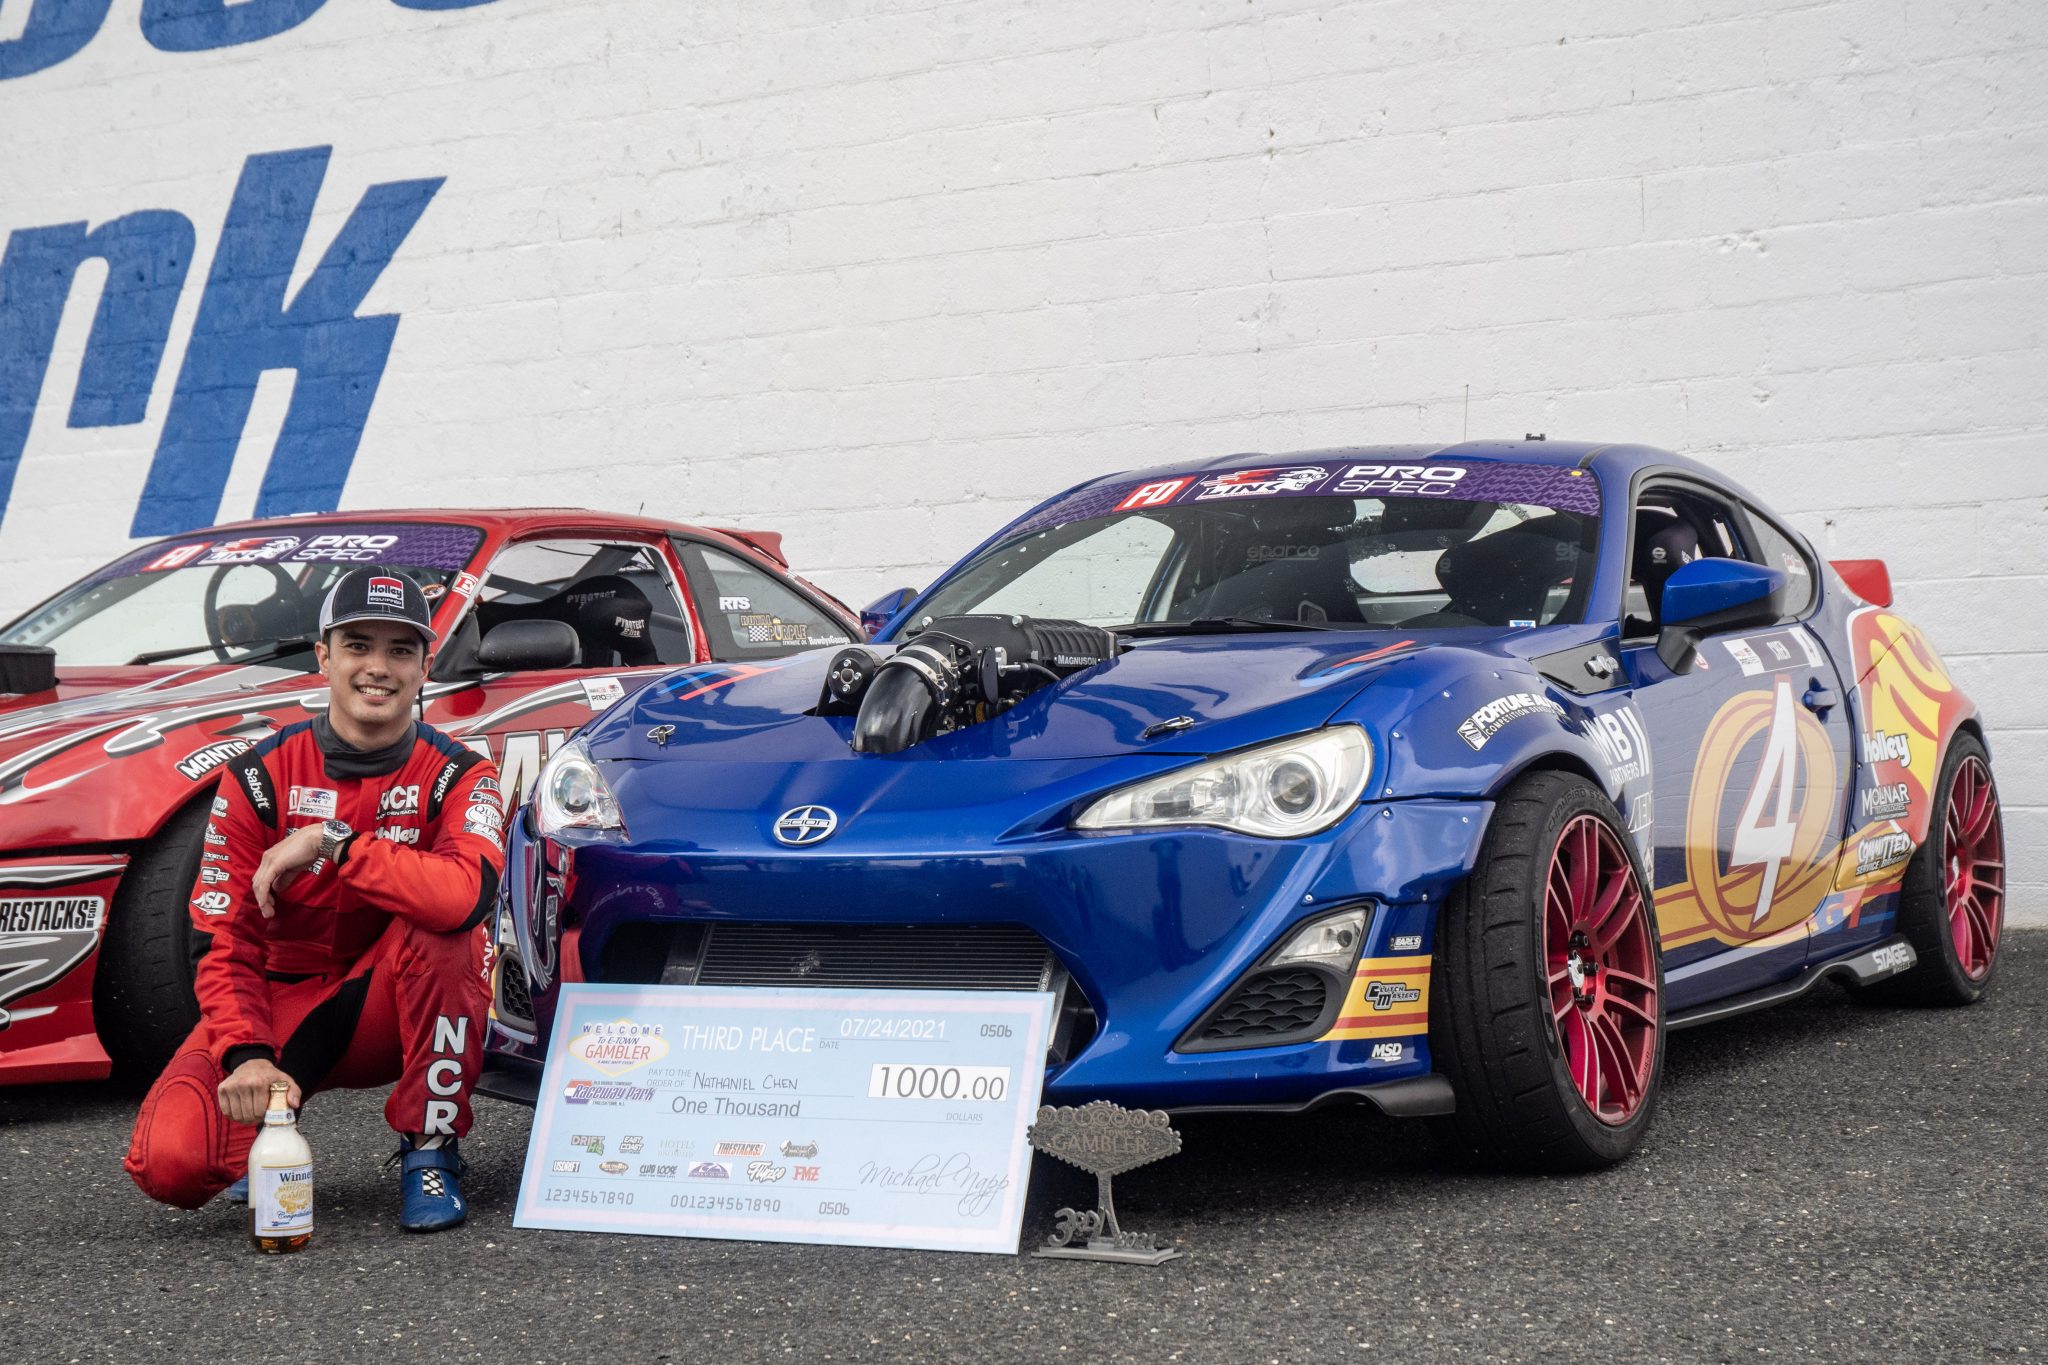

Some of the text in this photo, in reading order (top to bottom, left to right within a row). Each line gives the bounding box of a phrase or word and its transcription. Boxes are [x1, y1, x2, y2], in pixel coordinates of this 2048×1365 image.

[1344, 465, 1468, 481] PRO
[1122, 480, 1184, 508] FD
[1333, 480, 1456, 495] SPEC
[307, 535, 399, 548] PRO
[291, 548, 382, 562] SPEC
[1246, 545, 1320, 562] sparco
[370, 585, 402, 598] Holley
[768, 625, 807, 640] PURPLE
[1057, 655, 1097, 665] MAGNUSON
[1472, 693, 1535, 729] FORTUNE
[1485, 708, 1531, 736] COMPETITION
[1863, 730, 1911, 767] Holley
[244, 767, 270, 809] Sabelt
[434, 762, 459, 802] Sabelt
[1730, 680, 1798, 923] 4
[1862, 783, 1910, 817] MOLNAR
[1857, 831, 1911, 862] COMMITTED
[1872, 942, 1910, 972] STAGE
[582, 1024, 662, 1036] WELCOME
[840, 1018, 946, 1038] 07/24/2021
[683, 1025, 815, 1052] THIRD PLACE
[819, 1041, 840, 1049] DATE
[585, 1044, 651, 1060] GAMBLER
[1372, 1042, 1402, 1058] MSD
[648, 1068, 692, 1078] PAY TO THE
[646, 1079, 685, 1088] ORDER OF
[880, 1066, 1005, 1101] 1000.00
[572, 1084, 656, 1101] Raceway Park
[672, 1096, 800, 1118] One Thousand
[946, 1113, 983, 1122] DOLLARS
[572, 1135, 604, 1146] DRIFT
[620, 1143, 643, 1151] COAST
[1051, 1134, 1148, 1153] GAMBLER
[552, 1160, 580, 1173] USDRIFT
